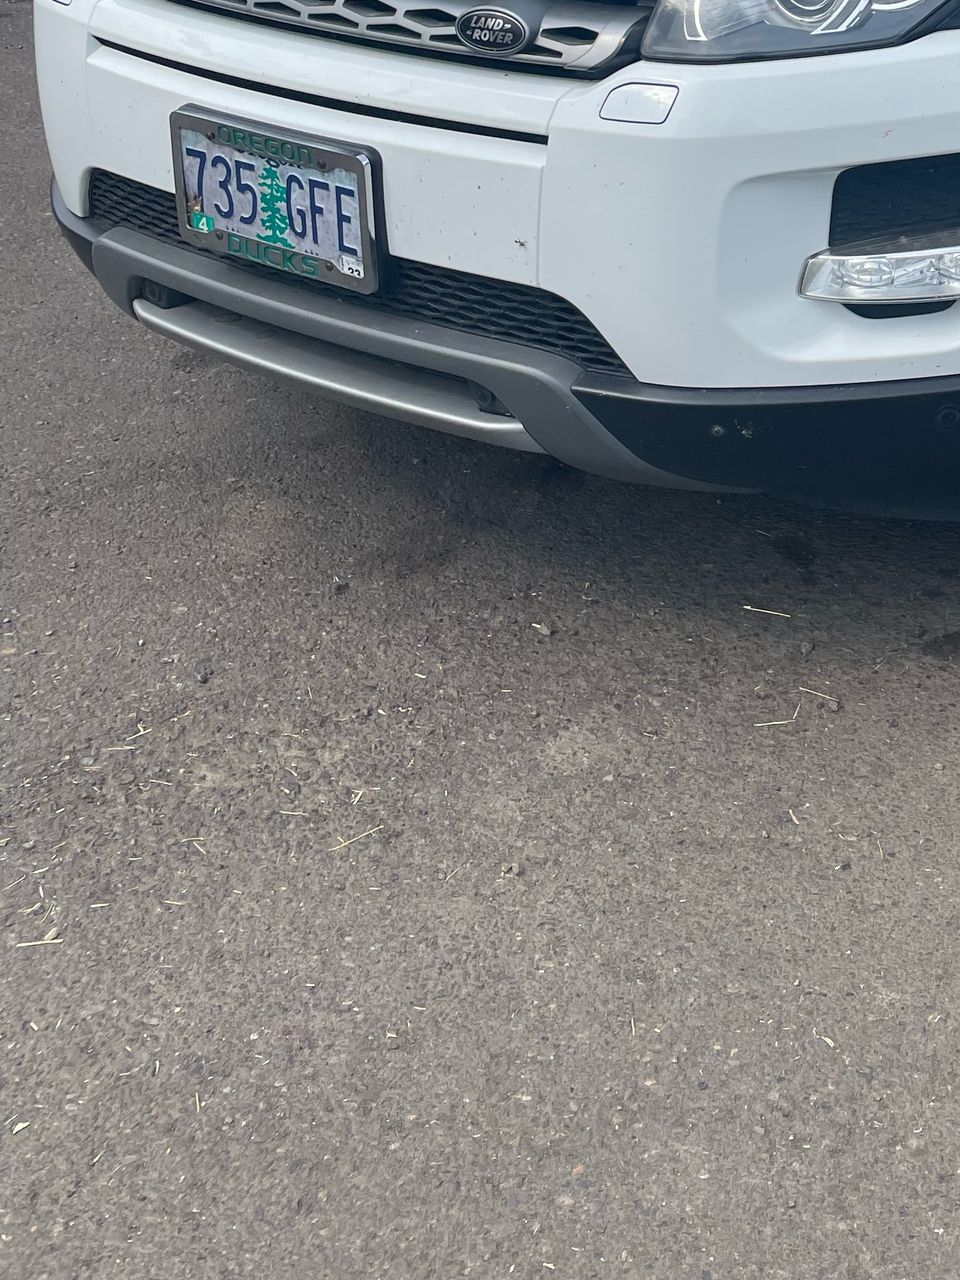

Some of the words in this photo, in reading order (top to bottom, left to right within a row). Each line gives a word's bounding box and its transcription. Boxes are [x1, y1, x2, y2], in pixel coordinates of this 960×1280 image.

[470, 15, 504, 31] LAND
[472, 28, 514, 45] ROVER
[185, 147, 258, 225] 735
[286, 173, 358, 257] GFE
[198, 218, 208, 232] 4
[227, 232, 320, 278] DUCKS
